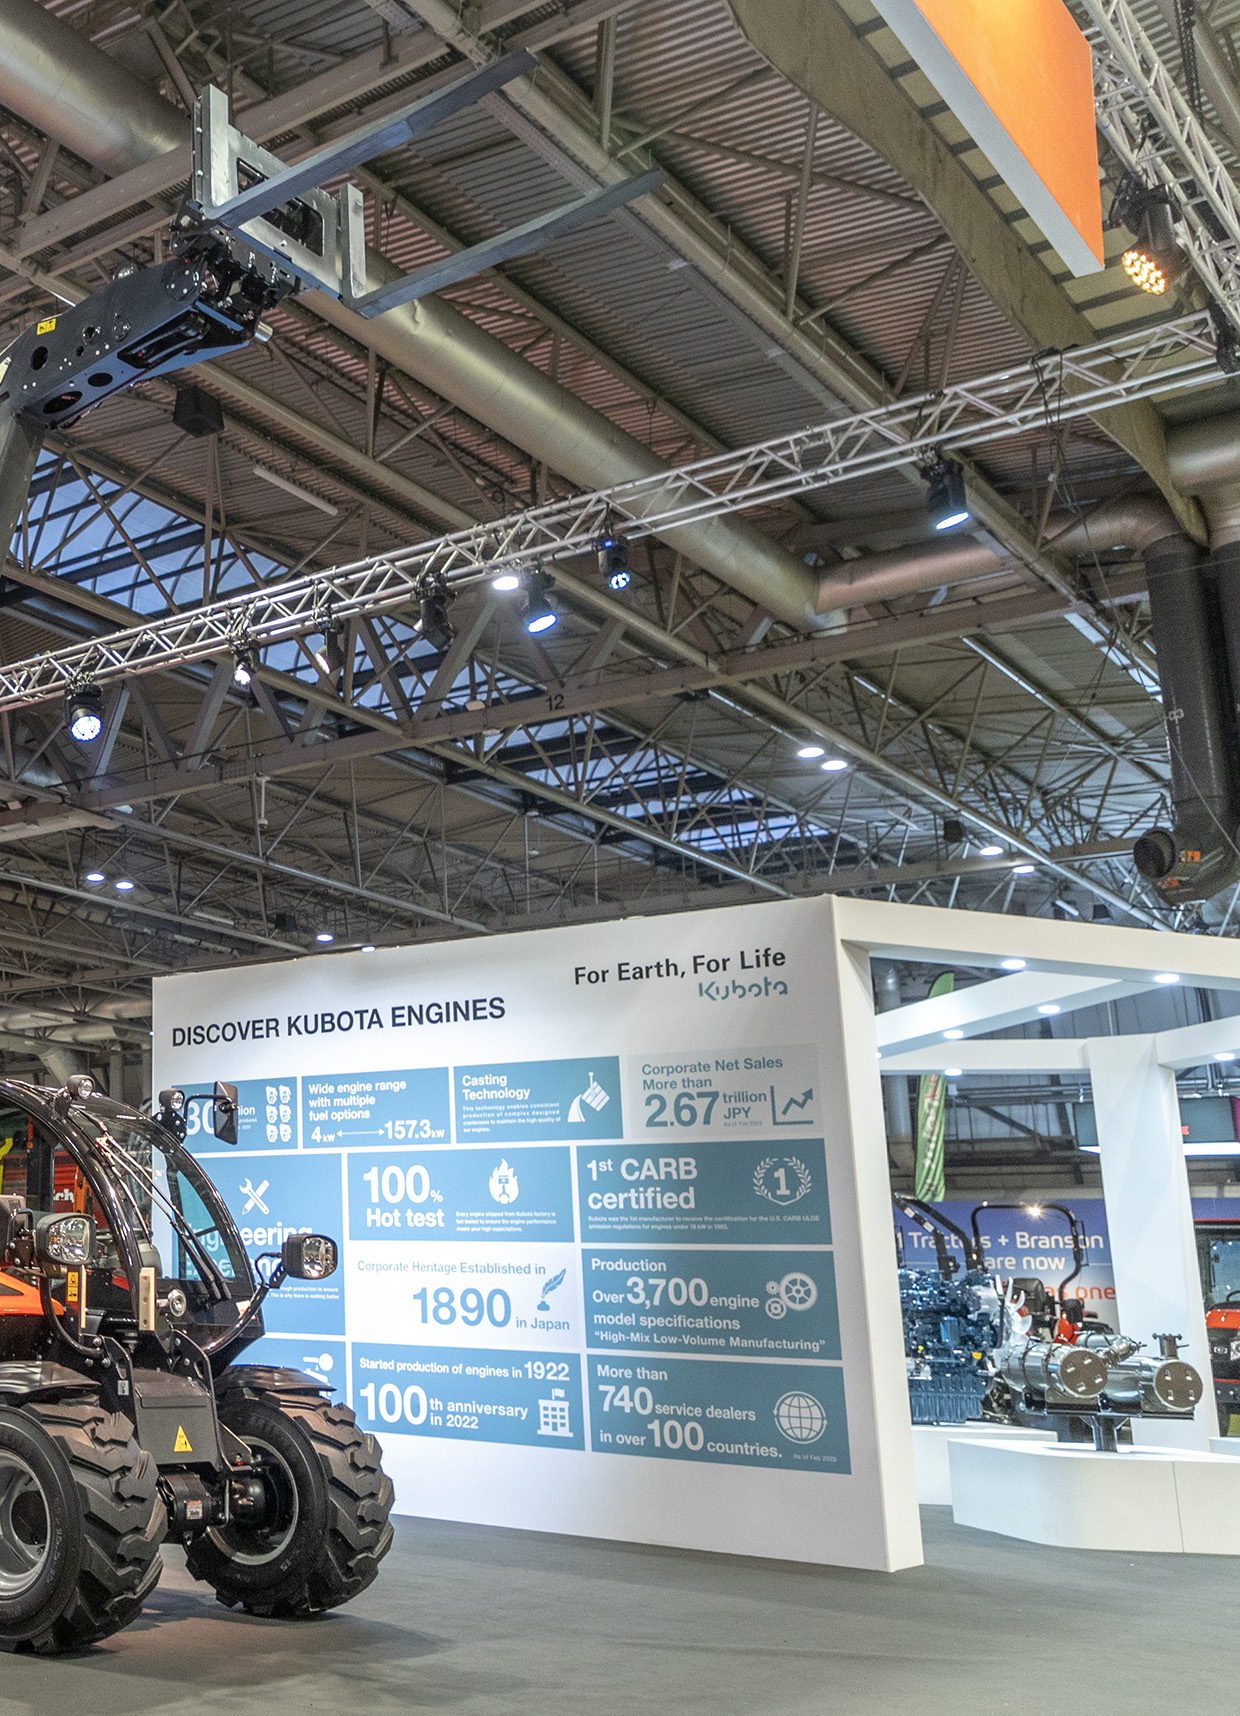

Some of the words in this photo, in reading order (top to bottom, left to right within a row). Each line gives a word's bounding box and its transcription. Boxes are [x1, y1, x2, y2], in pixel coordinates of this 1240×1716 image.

[545, 694, 565, 711] 12
[574, 966, 609, 985] For
[617, 958, 686, 981] Earth,
[692, 955, 730, 974] For
[740, 947, 786, 970] Life
[698, 976, 788, 1001] Kubota
[172, 1017, 280, 1047] DISCOVER
[287, 1008, 384, 1036] KUBOTA
[391, 997, 505, 1027] ENGINES
[641, 1061, 711, 1076] Corporate
[715, 1059, 740, 1071] Net
[744, 1057, 783, 1070] Sales
[308, 1083, 334, 1095] Wide
[337, 1081, 373, 1095] engine
[375, 1080, 407, 1093] range
[462, 1074, 507, 1087] Casting
[643, 1078, 677, 1090] More
[682, 1077, 712, 1088] than
[308, 1096, 331, 1108] with
[333, 1094, 376, 1108] multiple
[462, 1087, 530, 1101] Technology
[723, 1092, 767, 1103] trillion
[309, 1110, 328, 1121] fuel
[330, 1108, 371, 1122] options
[645, 1091, 720, 1128] 2.67
[724, 1107, 751, 1120] JPY
[587, 1158, 613, 1181] 1st
[620, 1157, 698, 1180] CARB
[773, 1167, 790, 1196] 1
[588, 1187, 696, 1210] certified
[366, 1208, 401, 1228] Hot
[407, 1208, 445, 1228] test
[1016, 1231, 1104, 1249] Branson
[357, 1260, 409, 1274] Corporate
[412, 1261, 458, 1275] Heritage
[460, 1262, 531, 1275] Established
[535, 1264, 546, 1275] in
[591, 1258, 667, 1272] Production
[983, 1257, 1016, 1270] are
[1022, 1256, 1066, 1270] now
[592, 1290, 625, 1304] Over
[626, 1276, 709, 1310] 3,700
[709, 1295, 760, 1310] engine
[1075, 1286, 1116, 1300] one
[412, 1287, 512, 1328] 1890
[516, 1316, 527, 1329] in
[530, 1318, 570, 1332] Japan
[593, 1313, 636, 1326] model
[639, 1314, 741, 1330] specifications
[653, 1334, 726, 1347] Low-Volume
[360, 1357, 395, 1371] Started
[396, 1359, 450, 1374] production
[452, 1363, 464, 1375] of
[466, 1366, 510, 1379] engines
[512, 1367, 523, 1379] in
[524, 1361, 570, 1382] 1922
[597, 1364, 633, 1379] More
[636, 1366, 668, 1381] than
[360, 1382, 428, 1426] 100
[447, 1400, 529, 1420] anniversary
[598, 1385, 653, 1416] 740
[655, 1403, 702, 1418] service
[705, 1406, 756, 1421] dealers
[430, 1413, 442, 1427] in
[446, 1414, 479, 1430] 2022
[600, 1430, 612, 1443] in
[616, 1433, 646, 1446] over
[647, 1419, 705, 1451] 100
[707, 1441, 783, 1458] countries.
